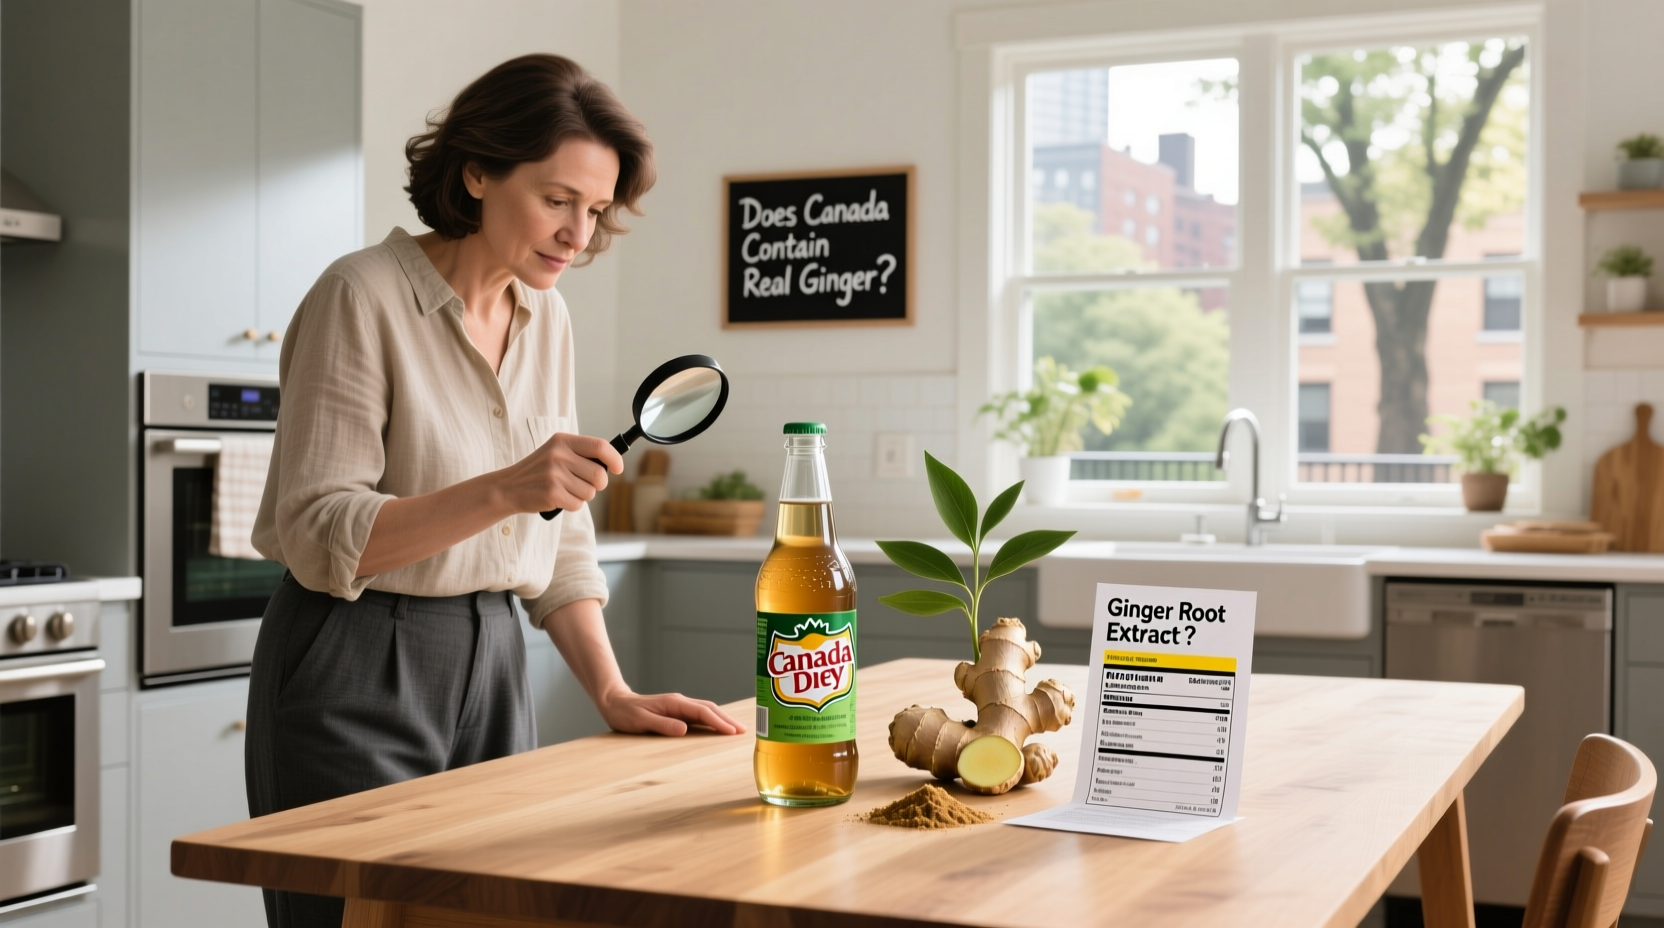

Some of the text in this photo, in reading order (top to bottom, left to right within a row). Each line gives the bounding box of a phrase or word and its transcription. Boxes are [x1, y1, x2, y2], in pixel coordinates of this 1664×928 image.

[738, 188, 890, 230] Does Canada
[741, 231, 830, 264] Contain
[743, 253, 897, 307] Real Ginger?
[1107, 597, 1226, 623] Ginger Root
[1106, 622, 1181, 645] Extract
[768, 640, 853, 676] Canada
